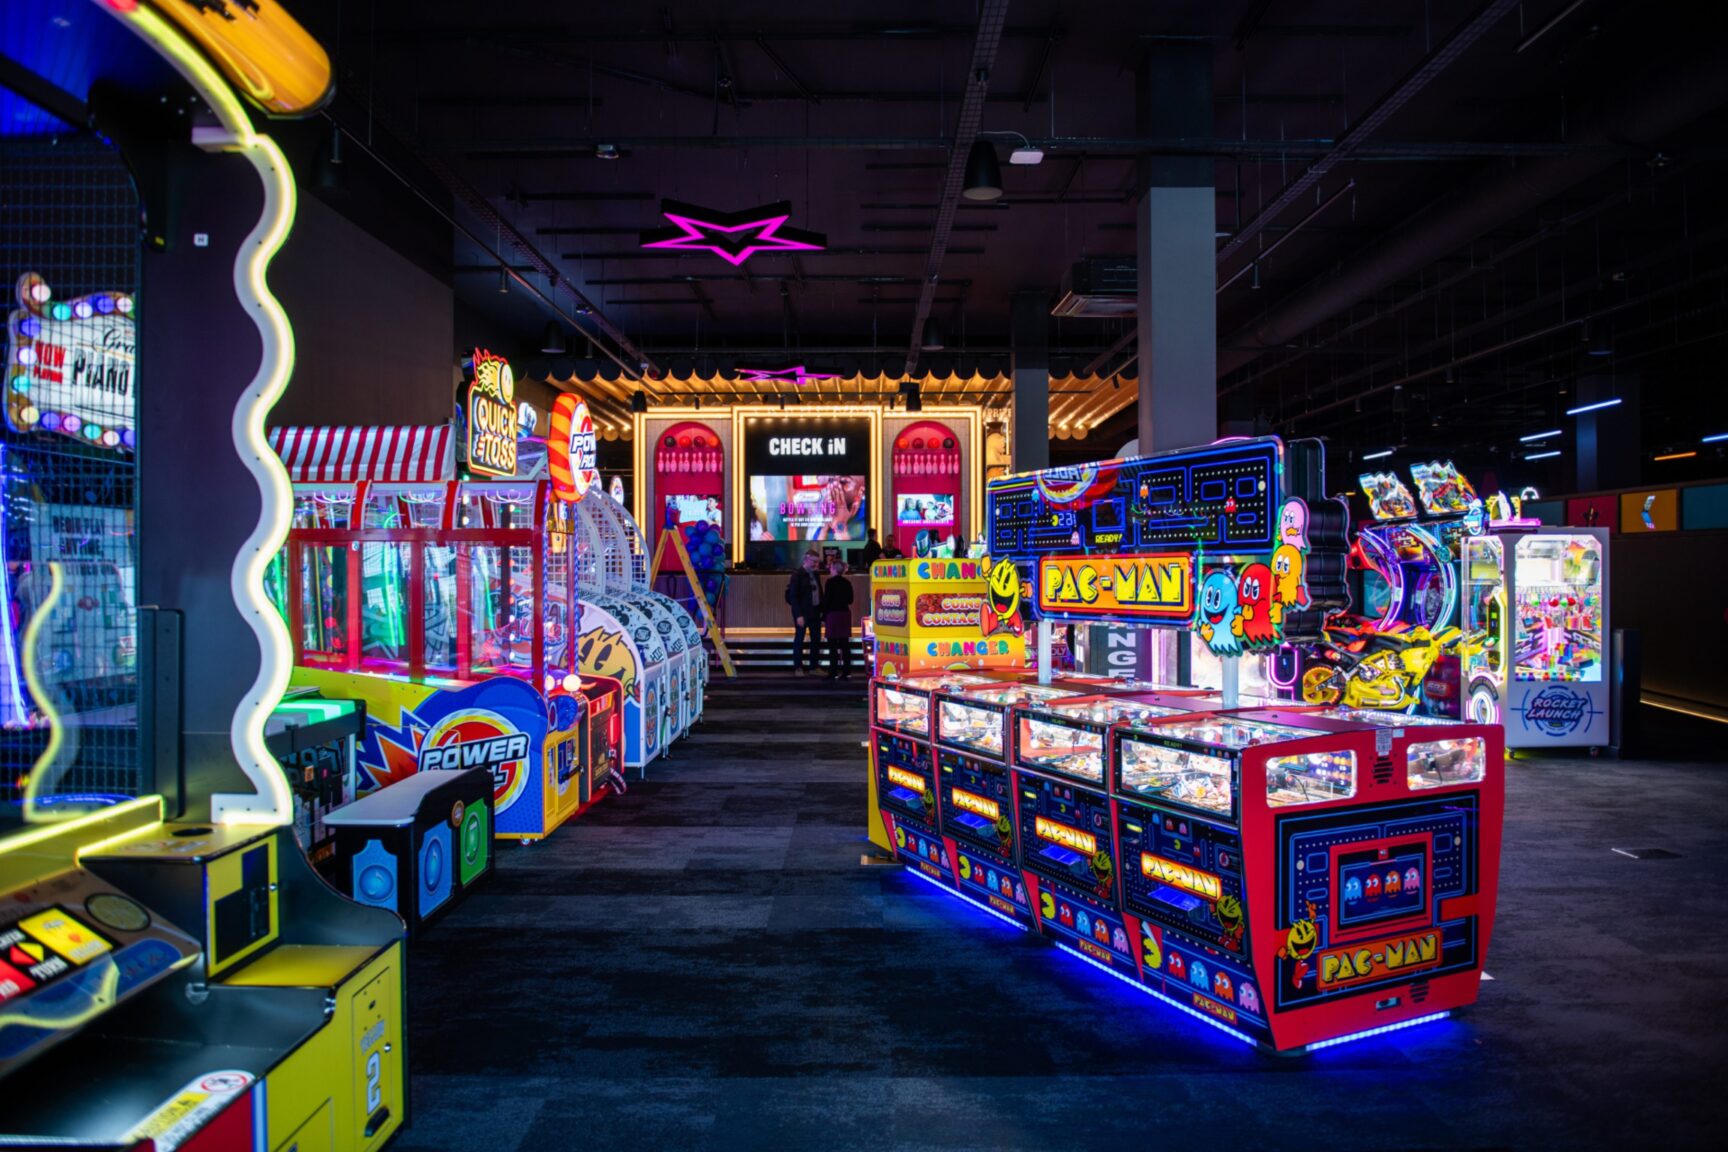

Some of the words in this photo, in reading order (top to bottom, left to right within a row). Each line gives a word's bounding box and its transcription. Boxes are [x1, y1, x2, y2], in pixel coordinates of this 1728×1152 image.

[73, 348, 130, 396] PIANO
[477, 397, 516, 440] QUICK
[484, 433, 515, 469] TOSS
[768, 437, 824, 456] CHECK
[780, 502, 836, 515] BOWLING
[1095, 533, 1123, 544] READY!
[874, 564, 907, 578] CHANGER
[917, 562, 982, 580] CHAN
[1045, 563, 1184, 606] PAC-MAN
[922, 612, 981, 626] CONTAC
[876, 640, 909, 657] CHANGER
[927, 640, 1009, 657] CHANGER
[1528, 708, 1582, 719] LAUNCH
[1533, 698, 1585, 709] ROCKET
[418, 733, 527, 771] POWER
[1037, 818, 1095, 853] PAC-MAN
[1143, 854, 1219, 898] PAC-MAN
[1321, 934, 1438, 984] PAC-MAN
[1194, 994, 1235, 1021] PAC-MAN
[366, 1051, 381, 1116] 2
